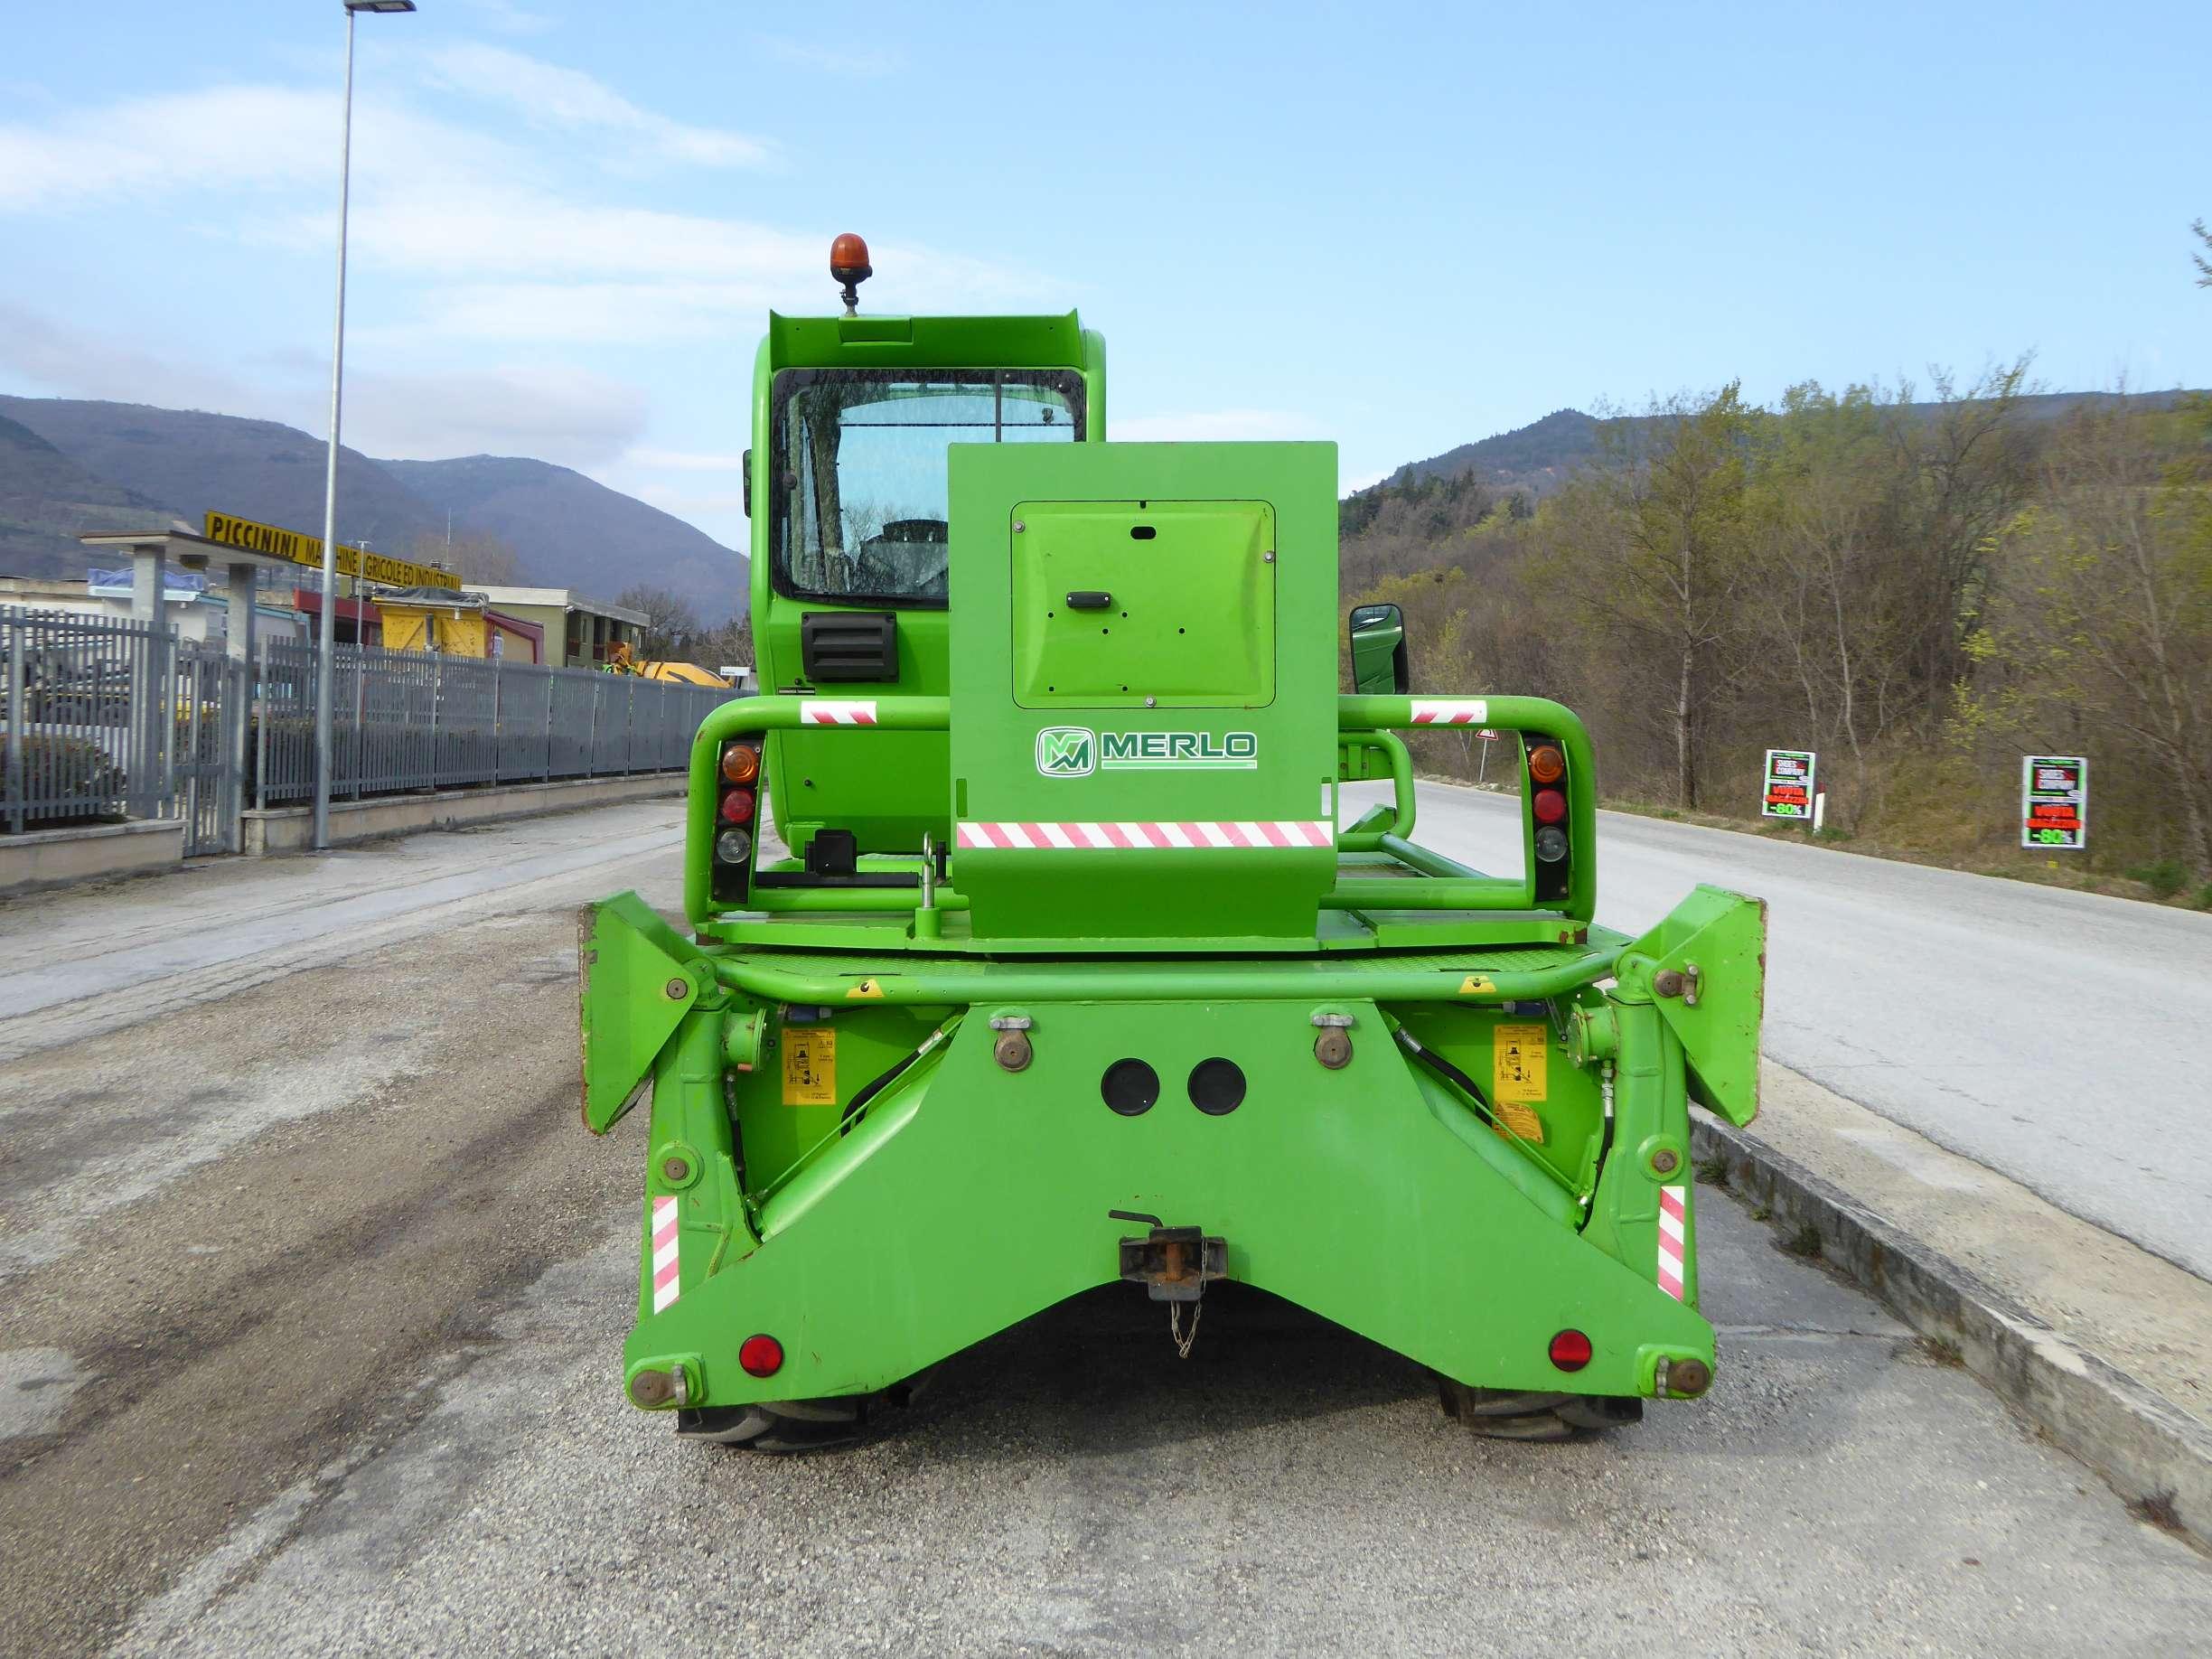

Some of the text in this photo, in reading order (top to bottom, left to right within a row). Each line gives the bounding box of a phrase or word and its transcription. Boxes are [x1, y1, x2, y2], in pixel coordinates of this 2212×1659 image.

[211, 516, 298, 558] PICCININI
[305, 539, 357, 573] MAHINE
[1101, 732, 1257, 758] MERLO
